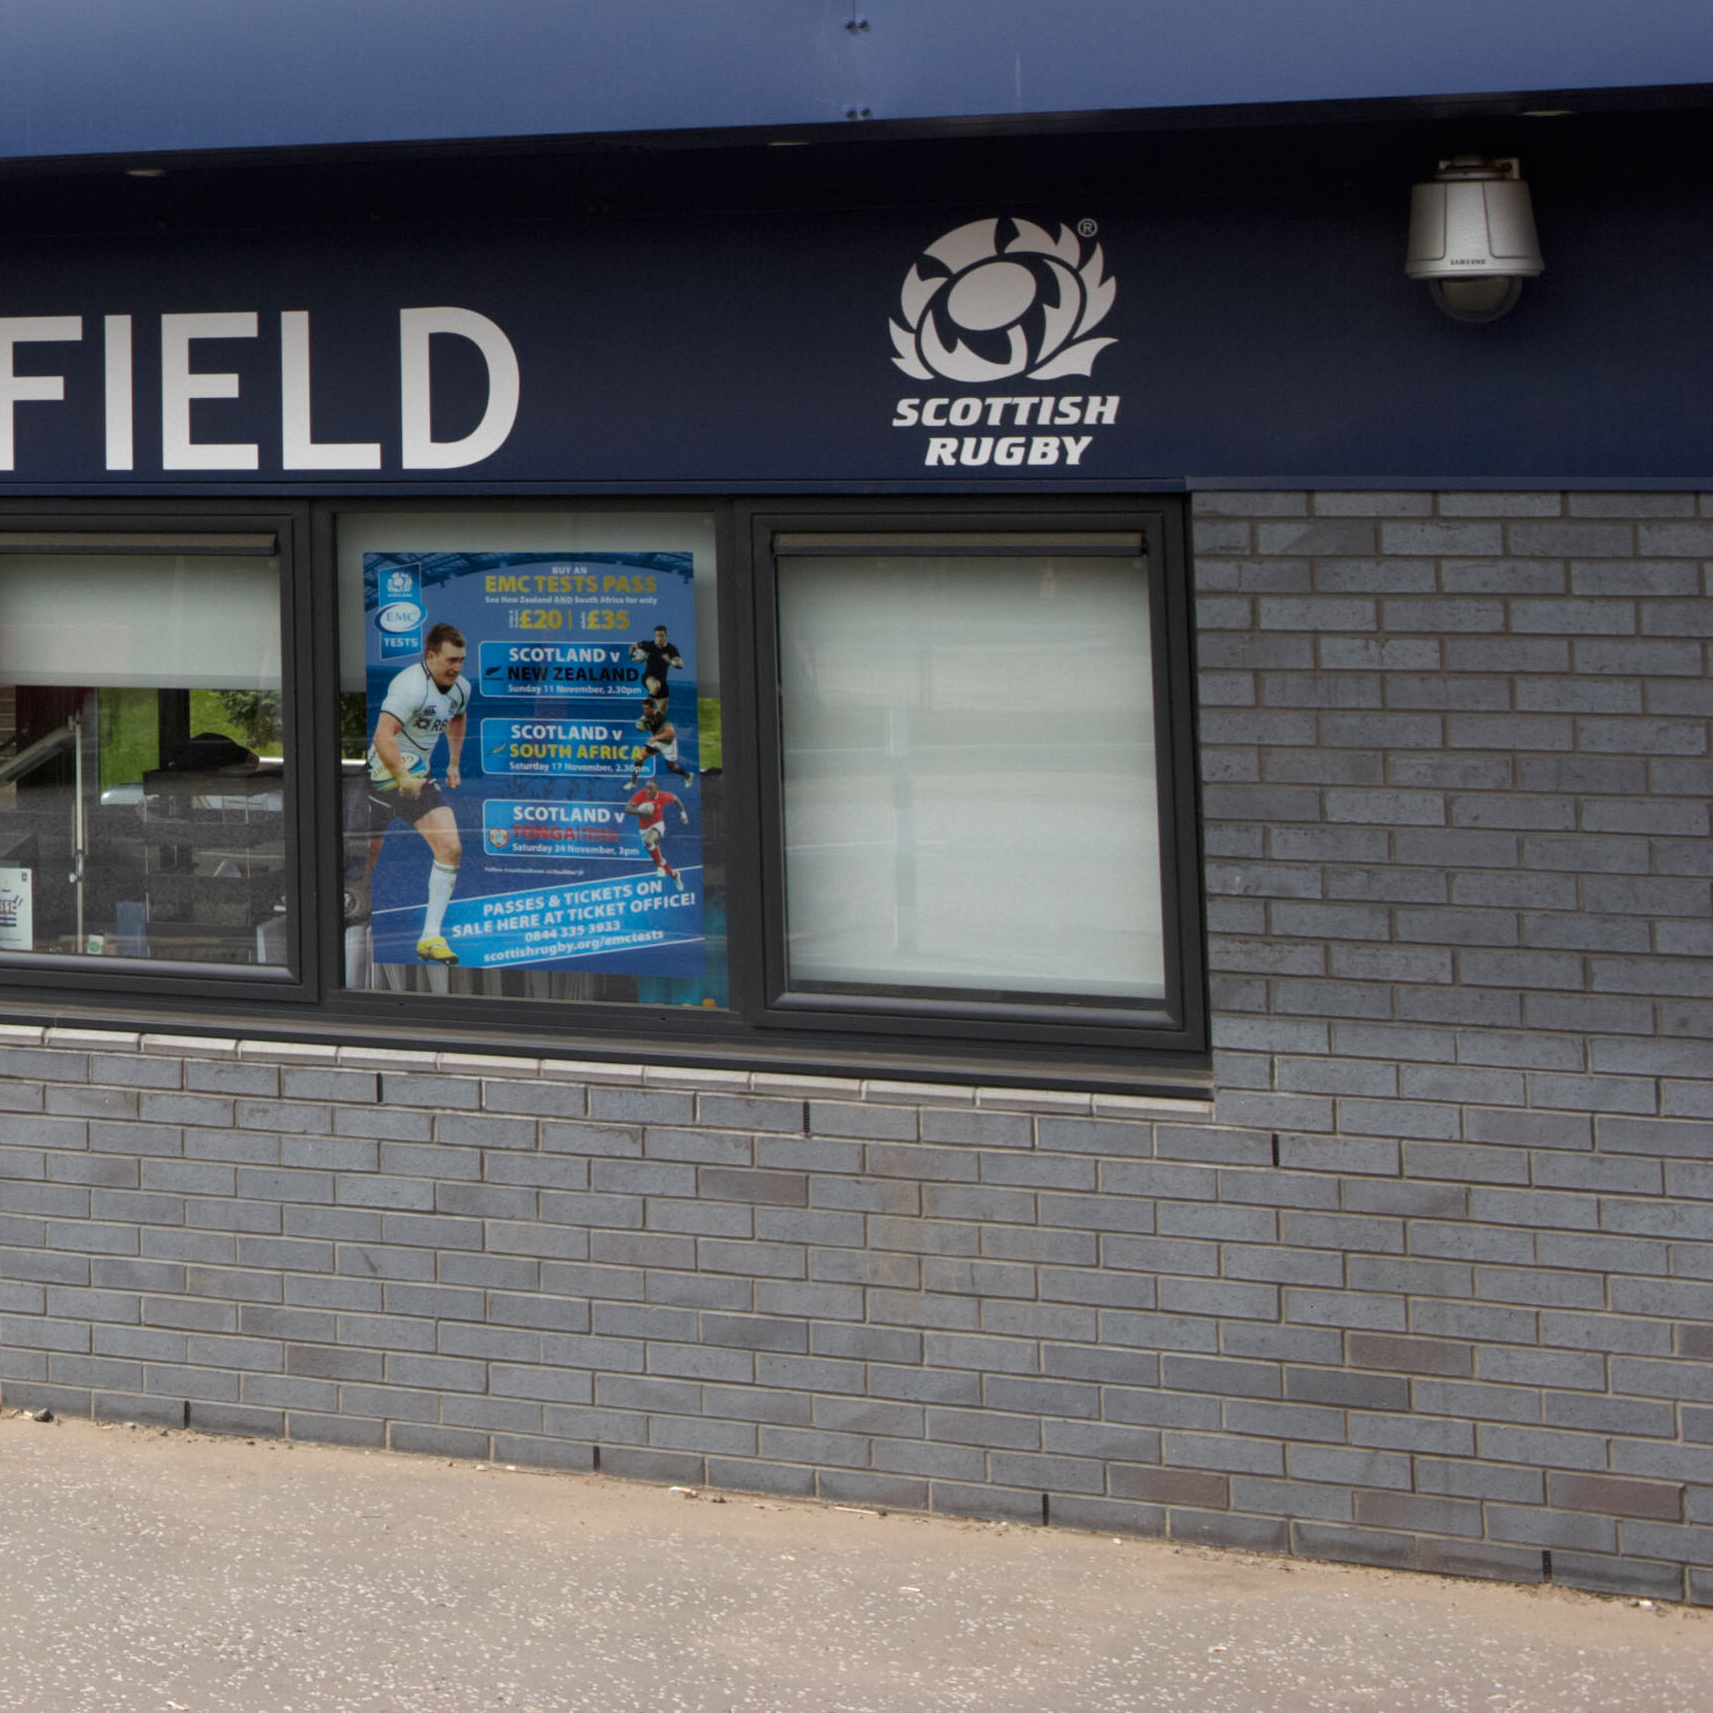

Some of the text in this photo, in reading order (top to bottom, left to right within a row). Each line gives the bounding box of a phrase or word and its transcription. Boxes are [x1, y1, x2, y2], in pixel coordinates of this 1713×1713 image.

[891, 395, 1120, 427] SCOTTISH
[924, 436, 1093, 466] RUGBY
[552, 566, 588, 575] BUY AN
[485, 575, 658, 594] EMC TESTS PASS
[519, 609, 563, 630] £20
[587, 609, 630, 630] £35
[384, 637, 419, 647] TESTS
[509, 647, 621, 663] SCOTLAND v
[507, 666, 639, 682] NEW ZEALAND
[508, 684, 642, 696] Sunday 11 November, 2.30pm
[511, 724, 623, 741] SCOTLAND v
[509, 744, 643, 761] SOUTH AFRICA
[509, 761, 650, 774] Saturday 17 November, 2.30pm
[513, 806, 626, 823] SCOTLAND v
[512, 825, 574, 841] TONGA
[512, 843, 640, 856] Saturday 24 November, 3pm
[483, 880, 663, 917] PASSES & TICKETS ON
[452, 892, 696, 938] SALE HERE AT TICKET OFFICE!
[525, 921, 621, 943] 0844 335 3933
[484, 929, 664, 963] scottishrugby.org/emctests
